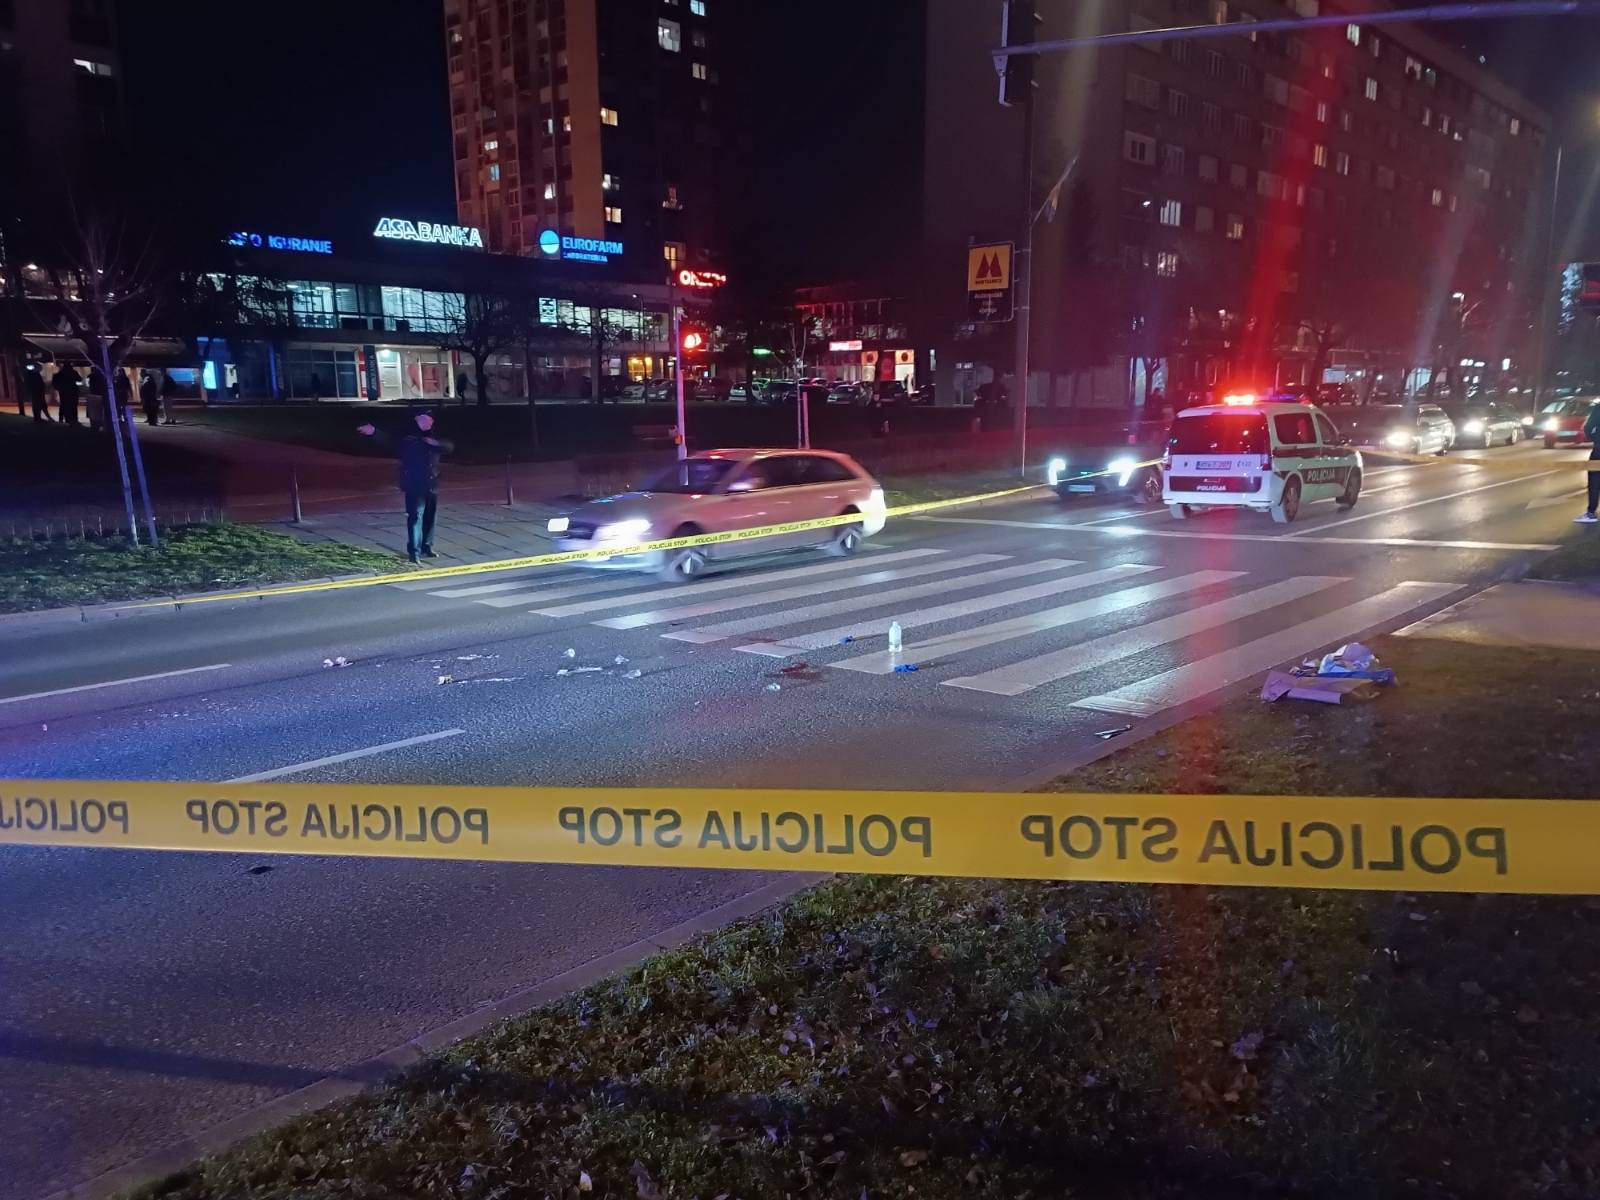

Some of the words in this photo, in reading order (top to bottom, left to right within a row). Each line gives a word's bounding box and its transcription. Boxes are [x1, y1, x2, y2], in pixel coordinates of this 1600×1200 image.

[418, 221, 483, 247] BANKA
[562, 236, 623, 255] EUROFARM
[1306, 468, 1336, 482] POLICIJA
